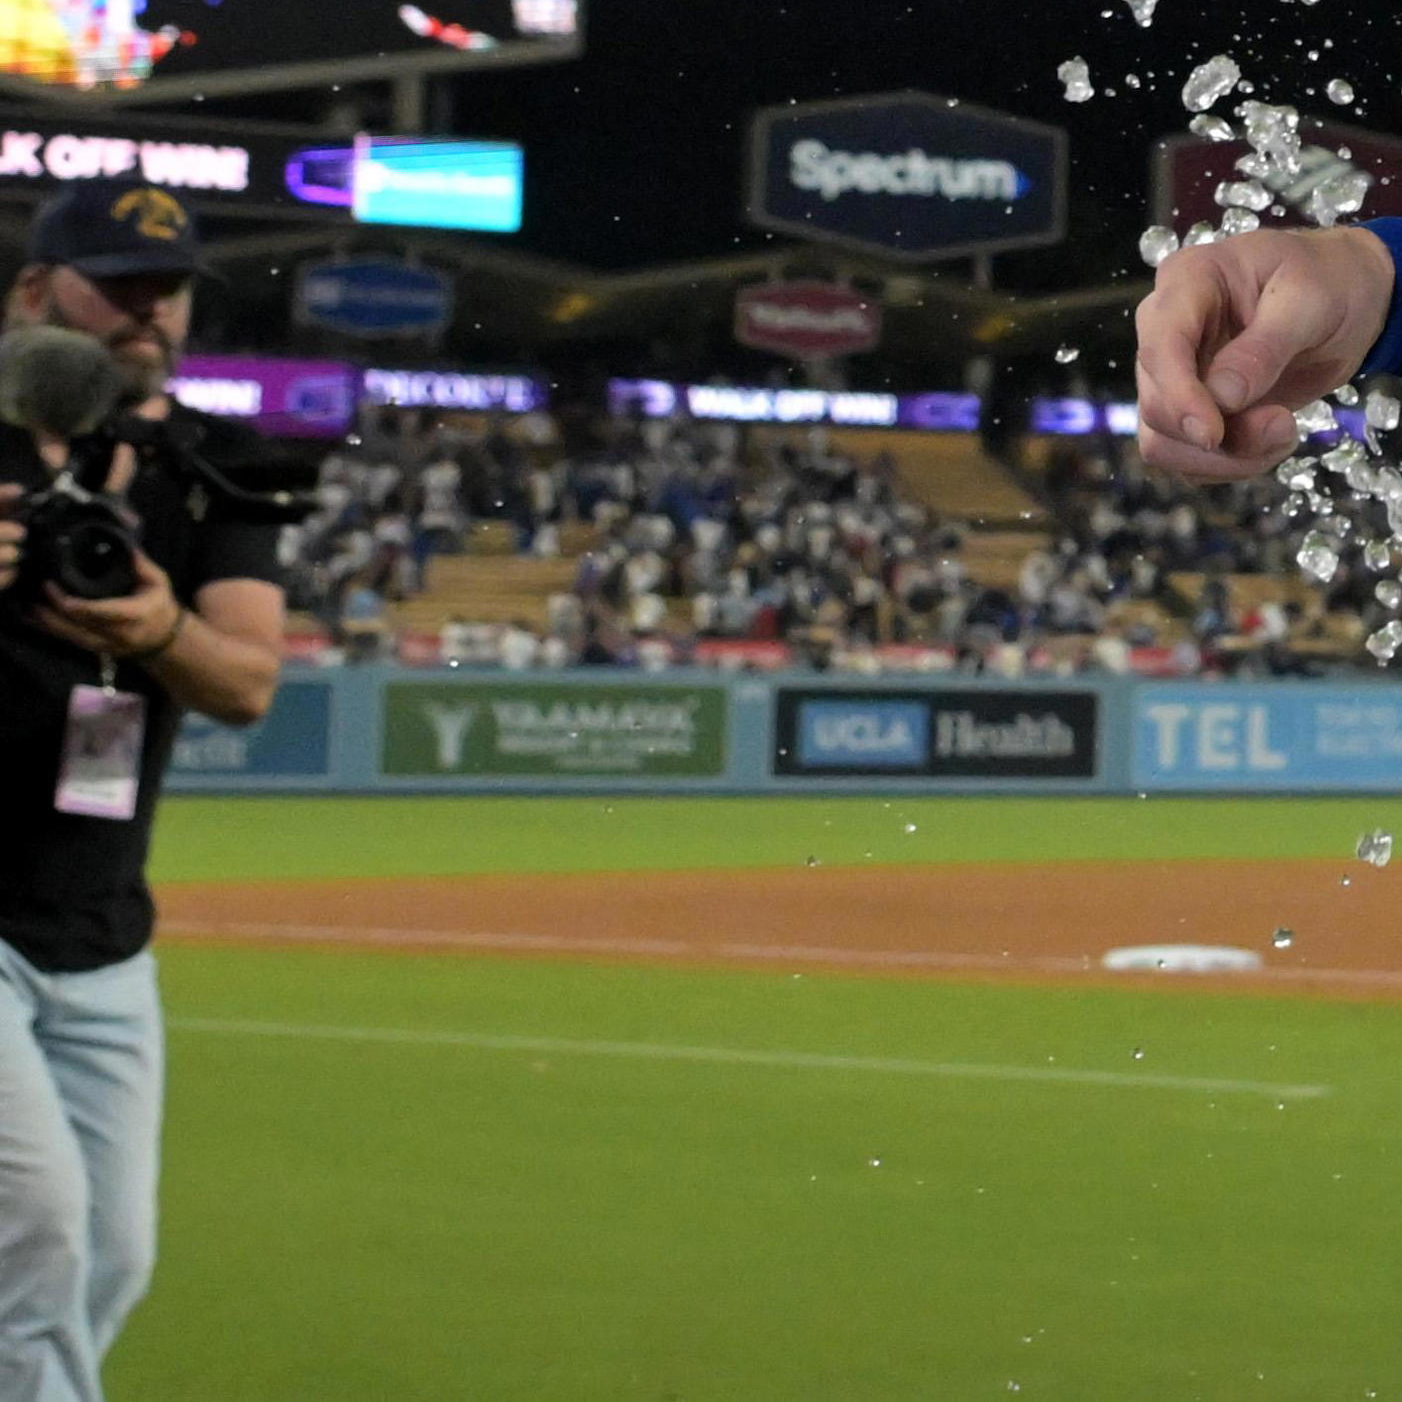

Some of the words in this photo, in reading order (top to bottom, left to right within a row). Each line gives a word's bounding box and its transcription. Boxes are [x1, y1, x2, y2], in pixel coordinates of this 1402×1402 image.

[789, 139, 1019, 200] Spectrum
[813, 713, 913, 753] UCLA
[934, 708, 1078, 760] Health
[1145, 705, 1290, 771] TEL
